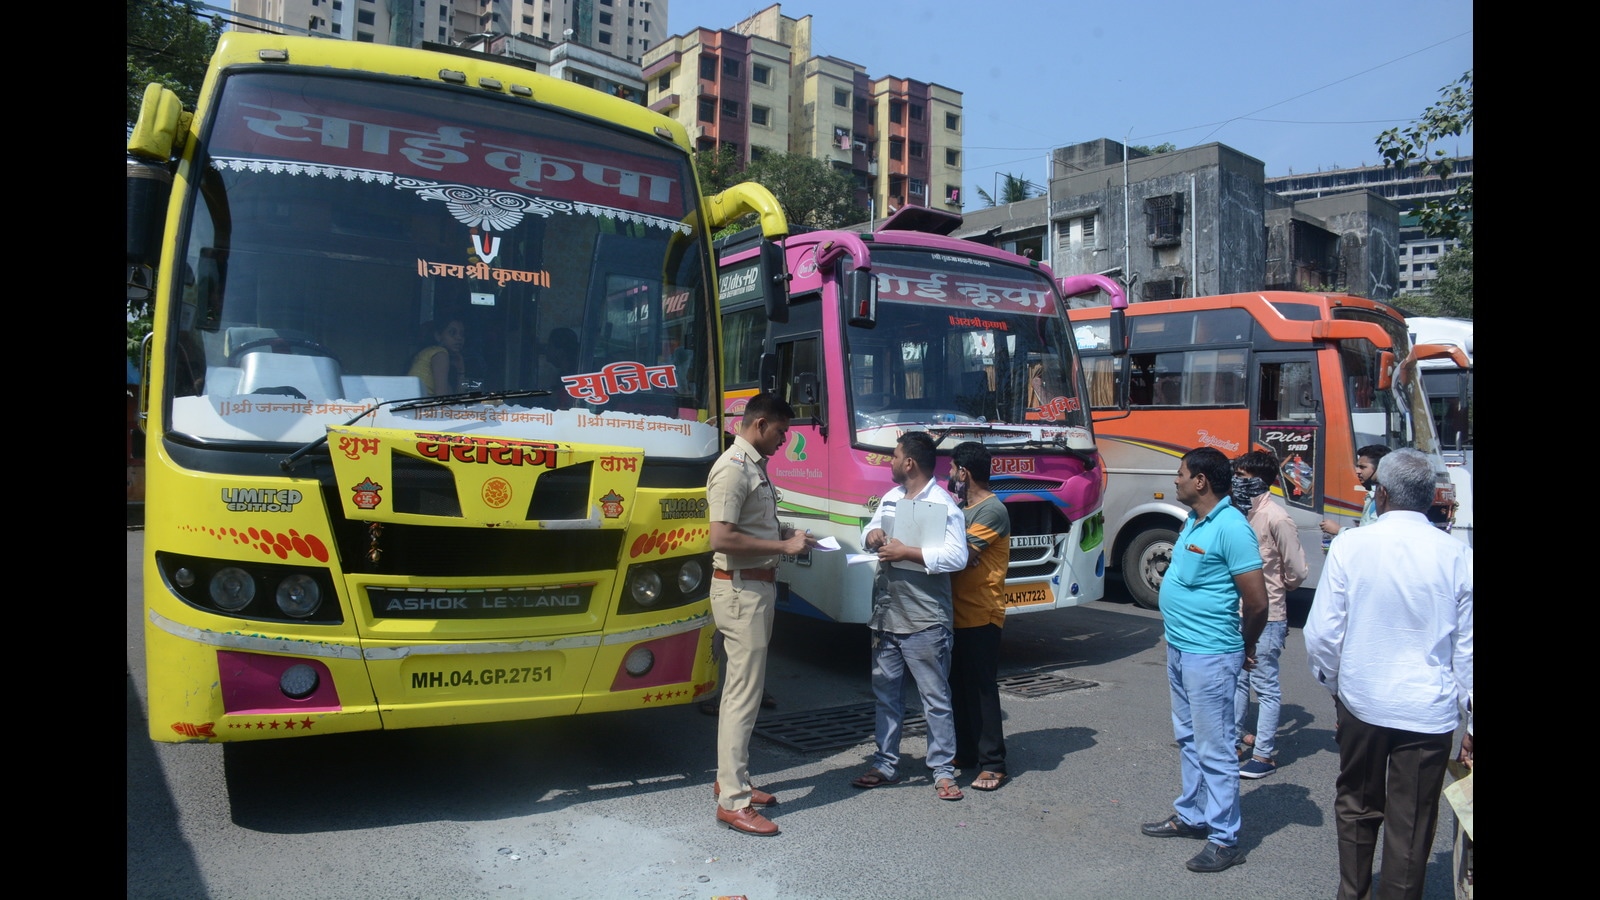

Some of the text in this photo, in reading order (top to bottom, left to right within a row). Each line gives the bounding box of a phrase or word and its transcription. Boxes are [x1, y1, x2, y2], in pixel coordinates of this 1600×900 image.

[237, 103, 677, 203] साई कृपा
[955, 282, 1048, 309] कृपा
[561, 361, 679, 405] सुजित
[1265, 430, 1312, 443] Pilot
[338, 436, 381, 460] शुभ
[1287, 444, 1309, 452] SPEED
[600, 455, 638, 473] लाभ
[775, 467, 805, 478] Incredible
[990, 456, 1036, 474] शराज
[221, 487, 303, 505] LIMITED
[659, 497, 709, 513] TURBO
[226, 503, 293, 513] EDITION
[1017, 535, 1054, 547] EDITION
[386, 595, 580, 611] ASHOK LEYLAND
[411, 666, 552, 689] MH.04.GP.2751
